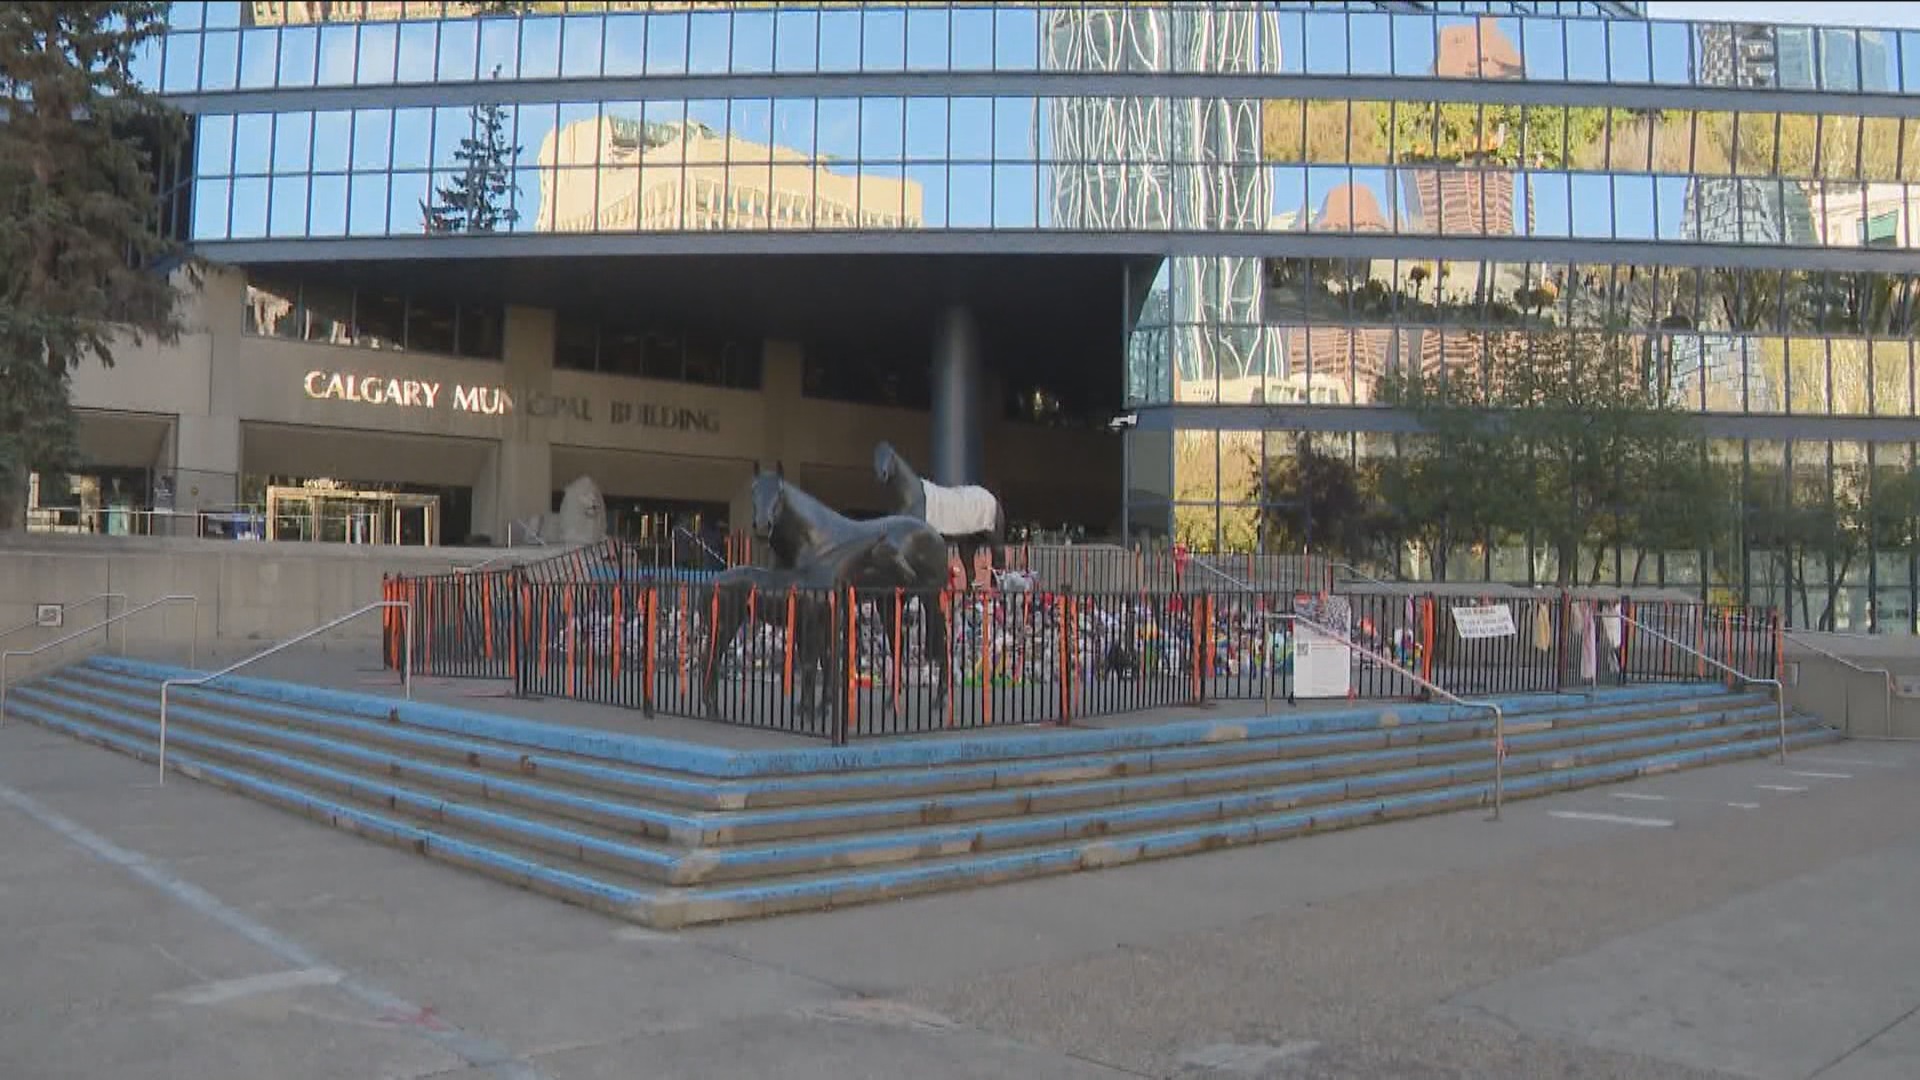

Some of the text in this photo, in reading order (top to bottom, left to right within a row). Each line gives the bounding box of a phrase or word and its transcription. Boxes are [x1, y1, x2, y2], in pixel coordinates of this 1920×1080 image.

[303, 370, 721, 433] CALGARY MUNCIPAL BUILDING
